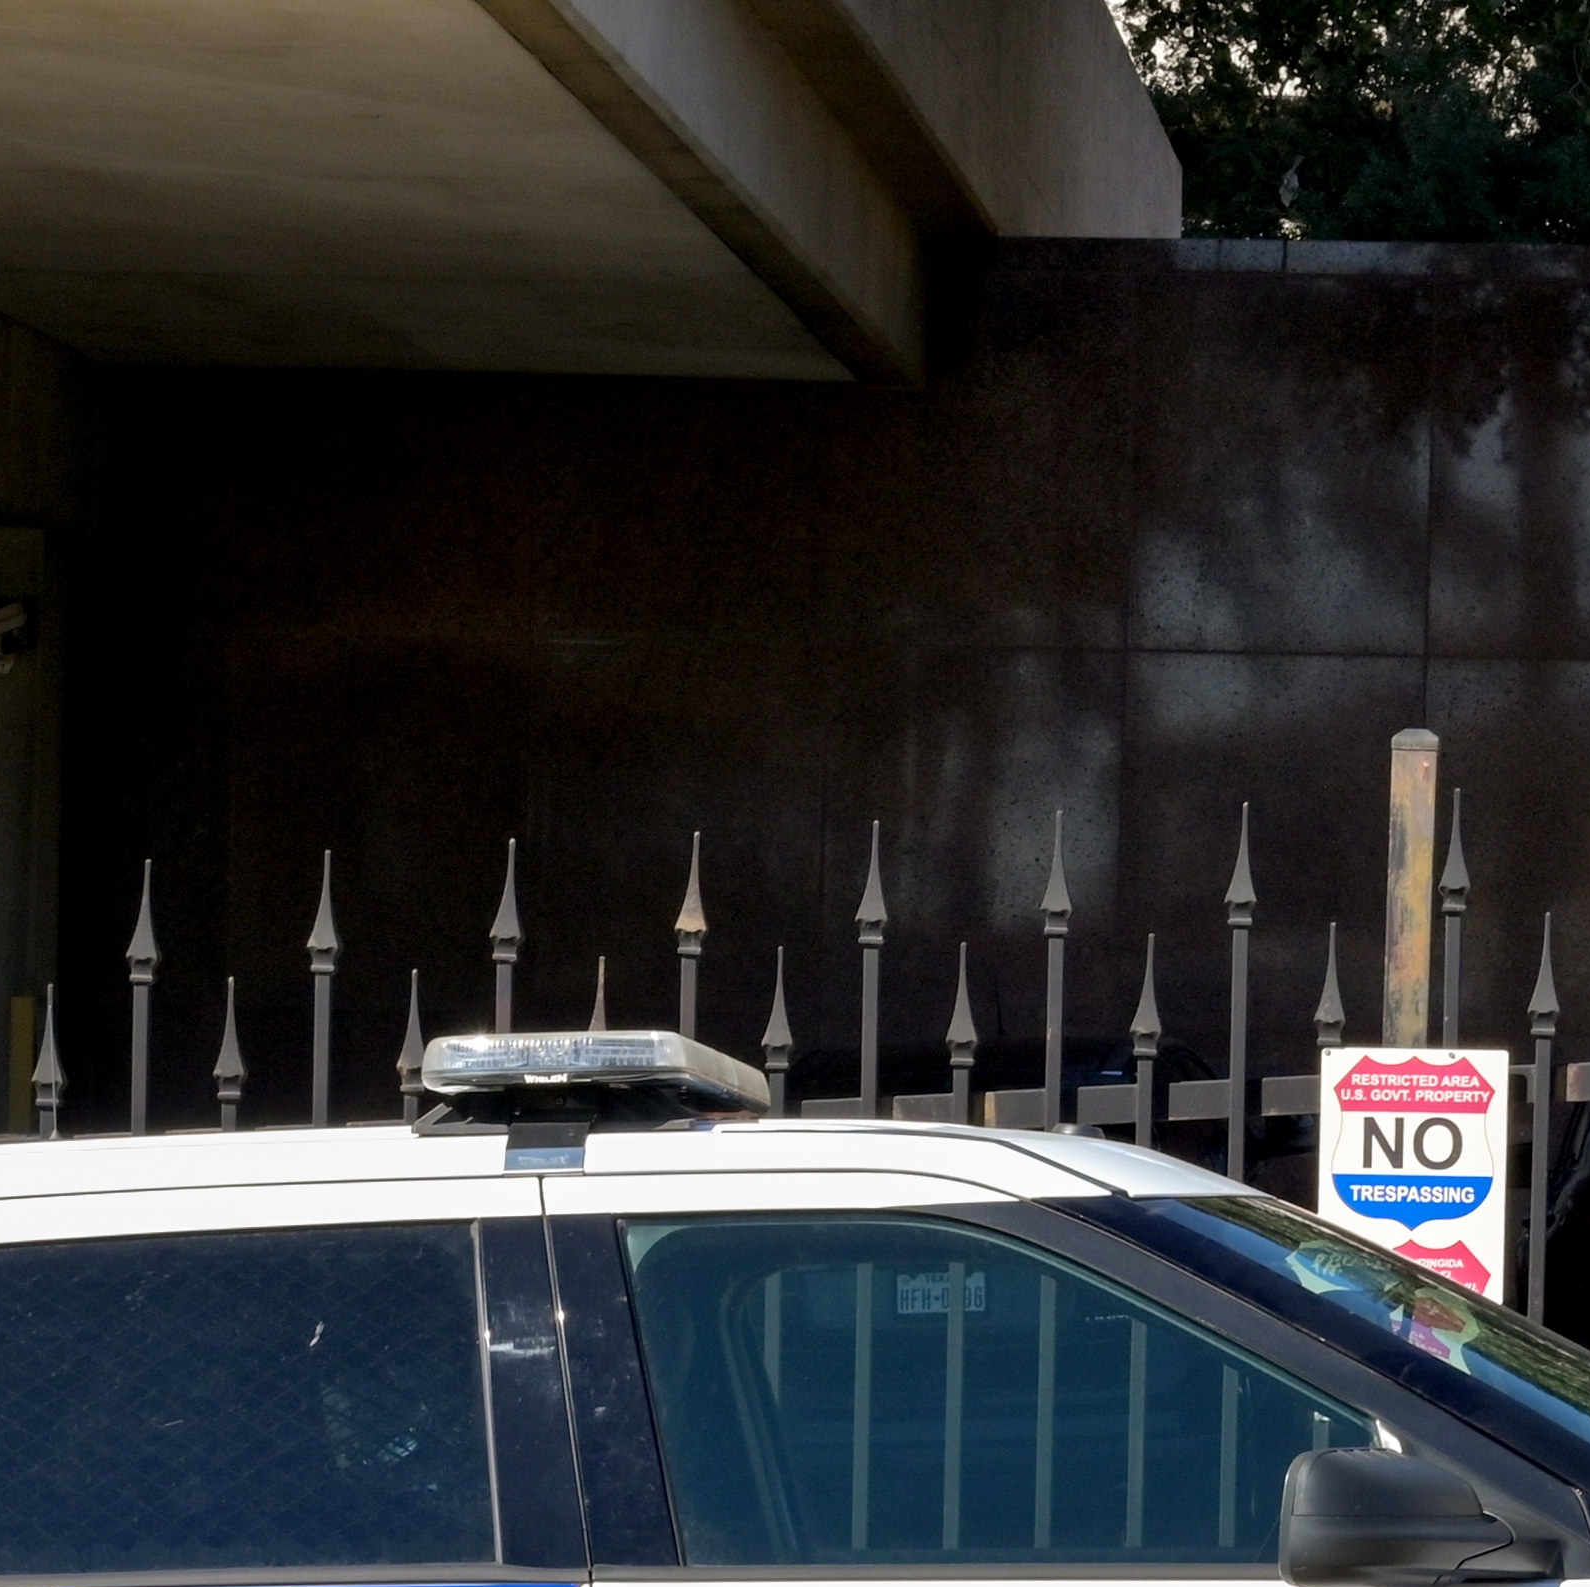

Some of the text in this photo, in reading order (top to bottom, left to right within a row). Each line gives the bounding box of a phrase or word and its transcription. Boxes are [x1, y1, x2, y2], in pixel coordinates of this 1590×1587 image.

[1351, 1073, 1480, 1088] RESTRICTED AREA
[1340, 1088, 1491, 1104] U.S. GOVT. PROPERTY
[1362, 1116, 1464, 1171] NO
[1350, 1184, 1475, 1204] TRESPASSING
